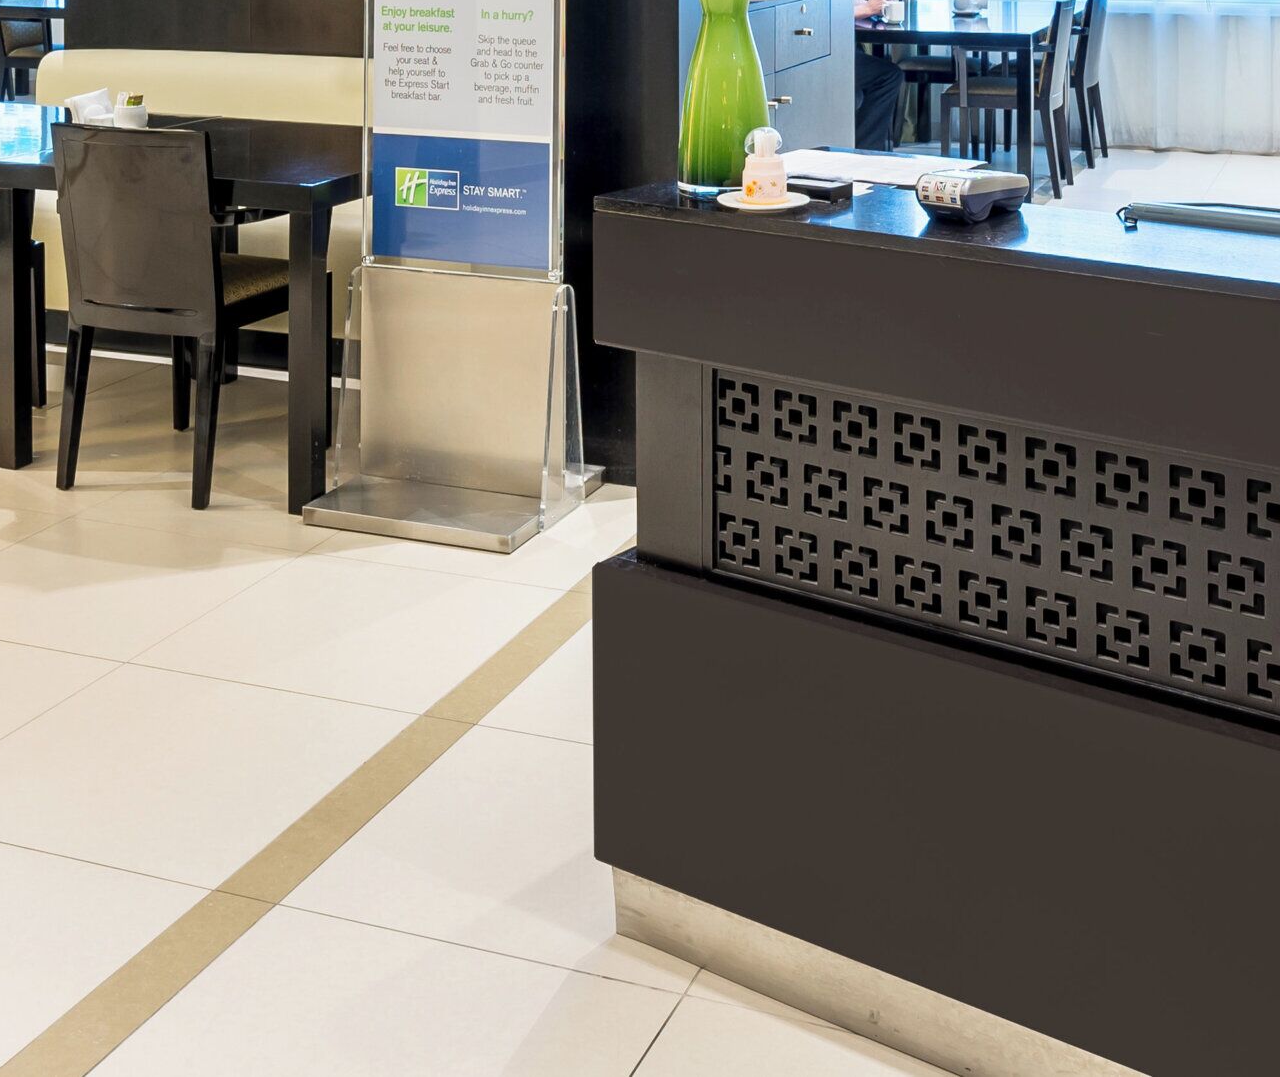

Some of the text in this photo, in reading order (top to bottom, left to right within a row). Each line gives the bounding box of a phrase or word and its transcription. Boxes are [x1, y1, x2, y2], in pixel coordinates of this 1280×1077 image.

[381, 6, 455, 19] Enjoy breakfast
[481, 9, 490, 19] In
[502, 10, 534, 23] hurry?
[383, 22, 452, 33] at your leisure.
[478, 35, 536, 47] Skip the queue
[383, 43, 399, 52] Feel
[401, 44, 415, 53] free
[426, 45, 451, 54] choose
[477, 47, 537, 58] and head to the
[396, 56, 437, 65] your seat &
[470, 58, 544, 70] Grab & Go counter
[389, 67, 404, 77] help
[406, 68, 436, 78] yourself
[494, 72, 510, 82] pick
[512, 73, 522, 83] up
[385, 78, 450, 90] the Express Start
[391, 90, 426, 100] breakfast
[514, 86, 539, 94] muffin
[478, 95, 492, 104] and
[495, 96, 514, 105] fresh
[430, 178, 449, 186] Holiday
[430, 186, 456, 196] Express
[463, 186, 485, 196] STAY
[462, 204, 526, 216] holidayinnexpress.com
